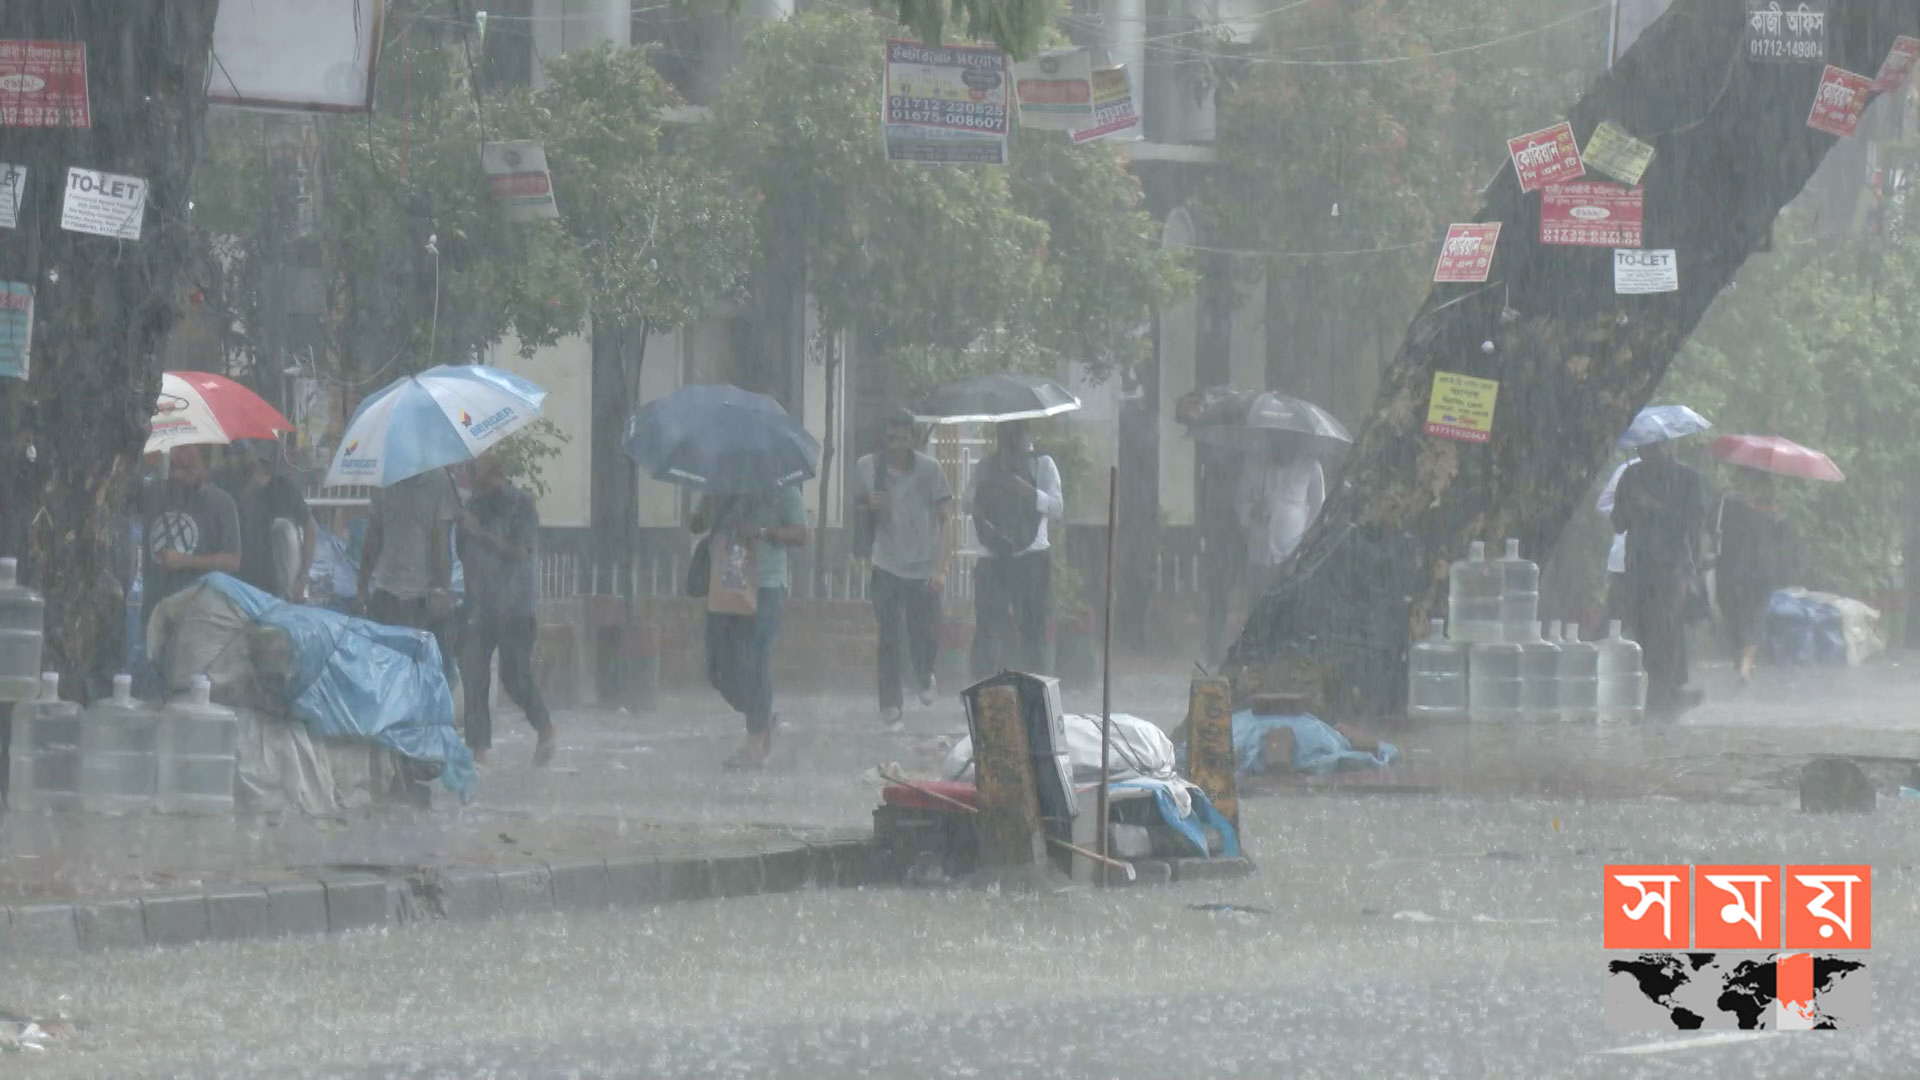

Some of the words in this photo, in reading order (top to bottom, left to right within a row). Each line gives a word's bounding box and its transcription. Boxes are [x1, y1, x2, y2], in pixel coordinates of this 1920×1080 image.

[1749, 1, 1783, 36] কাজী
[1785, 3, 1824, 37] অফিস
[891, 108, 1004, 130] 01675-008607
[71, 173, 140, 200] TO-LET
[1617, 253, 1669, 266] TO-LET
[470, 407, 515, 437] BERGER
[340, 459, 377, 469] BERGER
